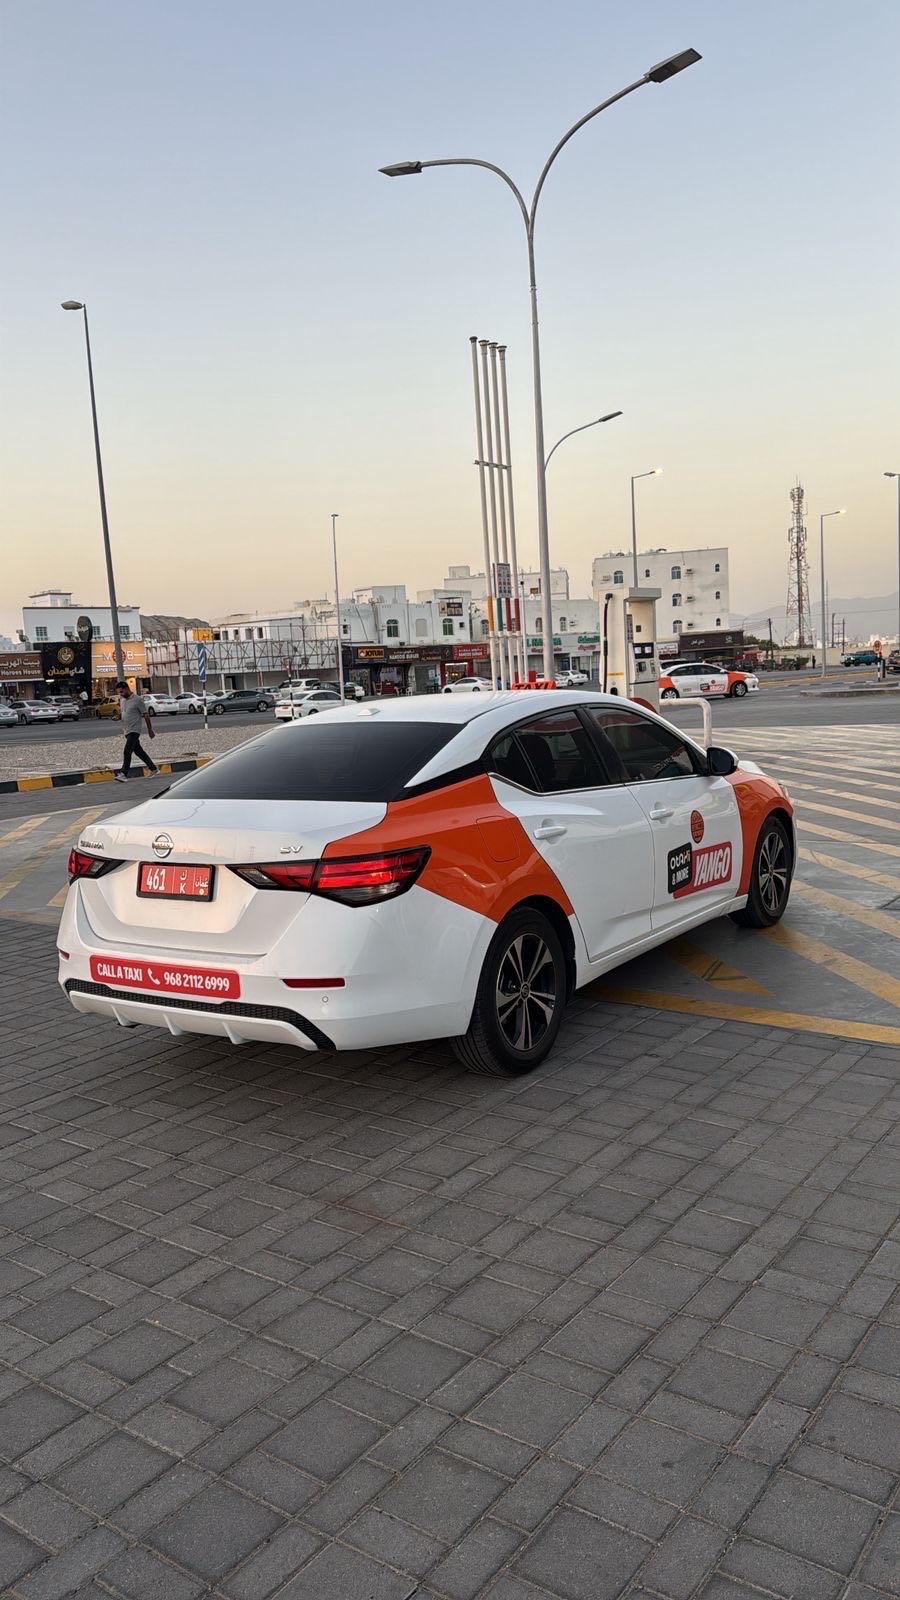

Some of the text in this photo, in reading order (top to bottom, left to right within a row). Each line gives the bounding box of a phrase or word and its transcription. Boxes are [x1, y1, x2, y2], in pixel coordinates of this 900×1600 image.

[280, 845, 304, 854] SV
[676, 866, 689, 883] MORE
[693, 846, 731, 887] YANGO
[146, 868, 166, 890] 461
[179, 883, 186, 894] K
[97, 963, 230, 992] CALL A TAXI 968 2112 6999
